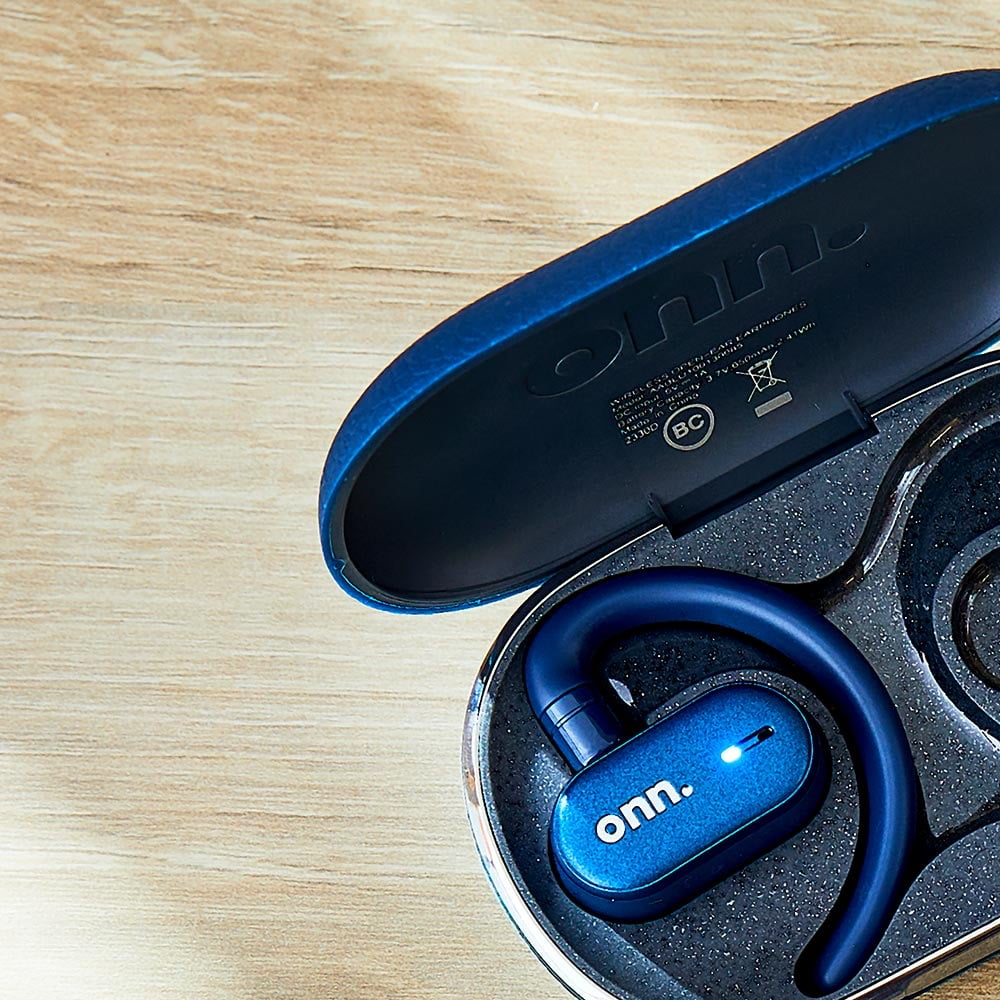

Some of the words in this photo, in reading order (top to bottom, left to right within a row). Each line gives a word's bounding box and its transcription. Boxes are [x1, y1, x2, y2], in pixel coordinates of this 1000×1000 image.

[523, 221, 868, 398] onn.
[672, 414, 705, 440] BC
[596, 780, 694, 844] onn.
